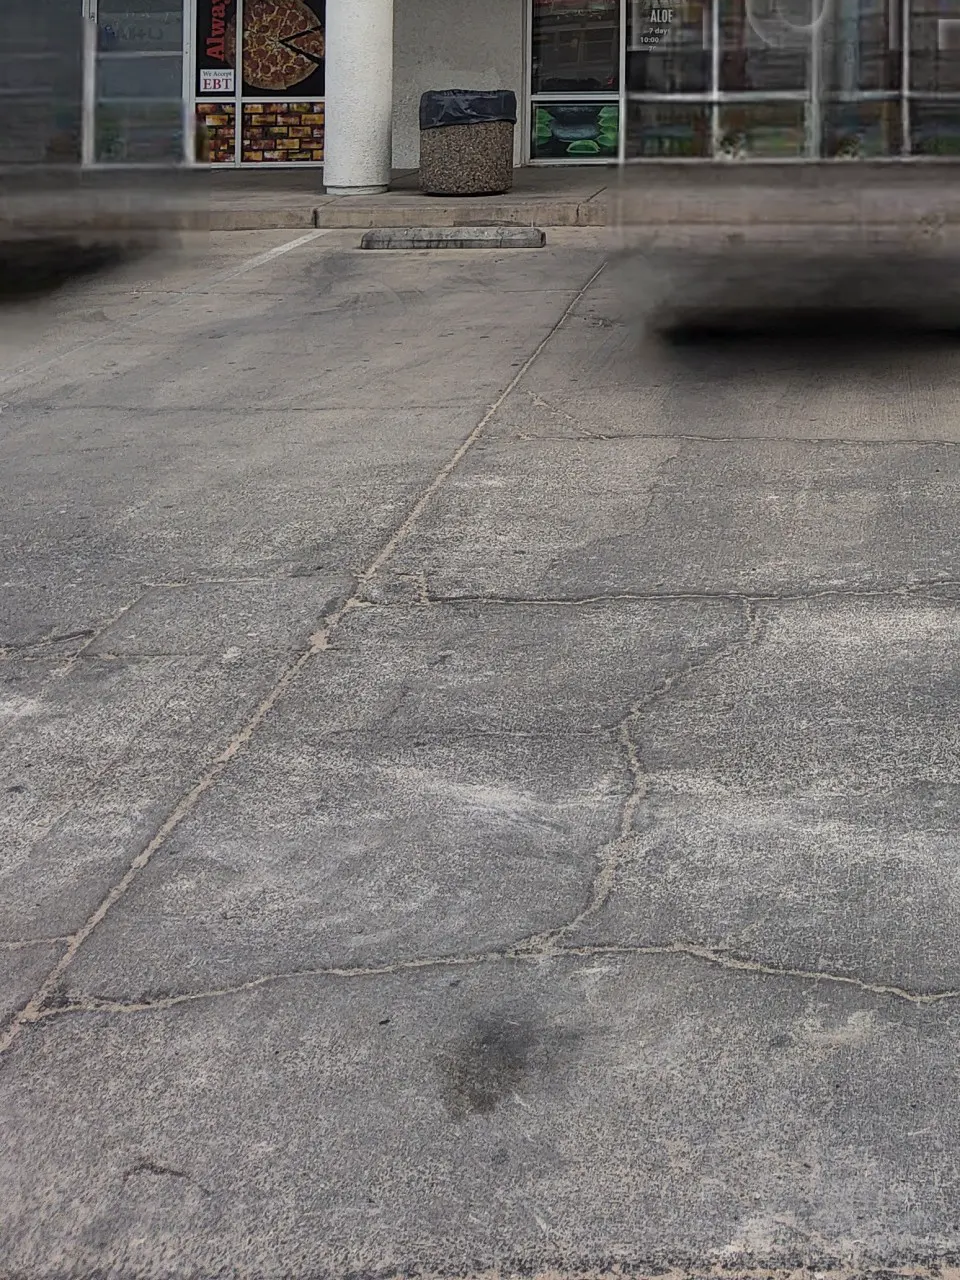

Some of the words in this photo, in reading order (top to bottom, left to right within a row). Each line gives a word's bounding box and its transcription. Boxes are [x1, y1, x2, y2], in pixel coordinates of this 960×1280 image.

[650, 9, 673, 23] ALOE
[639, 36, 660, 44] 10:00
[212, 70, 233, 78] Accept
[202, 78, 233, 90] EBT
